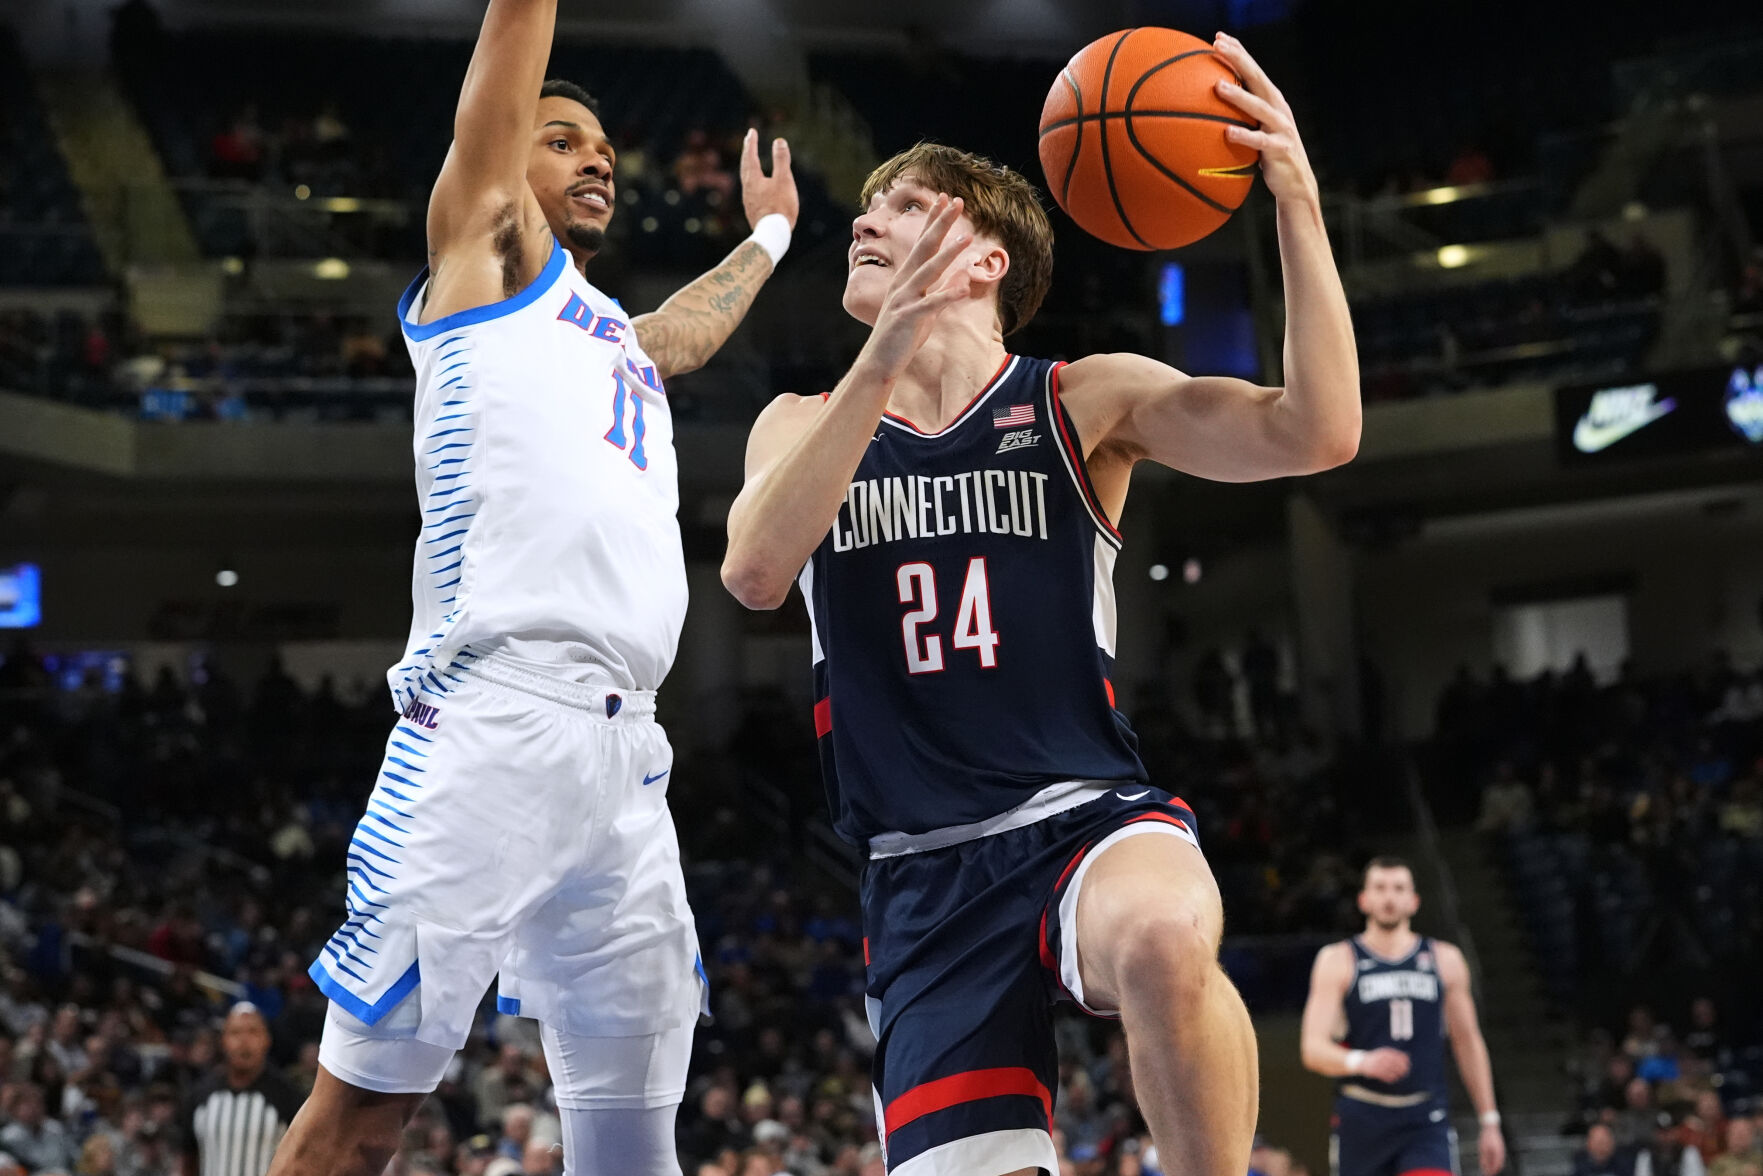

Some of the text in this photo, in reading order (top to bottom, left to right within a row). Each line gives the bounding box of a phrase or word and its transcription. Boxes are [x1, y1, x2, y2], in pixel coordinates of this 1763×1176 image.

[603, 368, 648, 471] 11
[998, 434, 1042, 450] EAST
[1002, 429, 1033, 442] BIG
[832, 469, 1049, 553] CONNECTICUT
[895, 555, 1001, 676] 24
